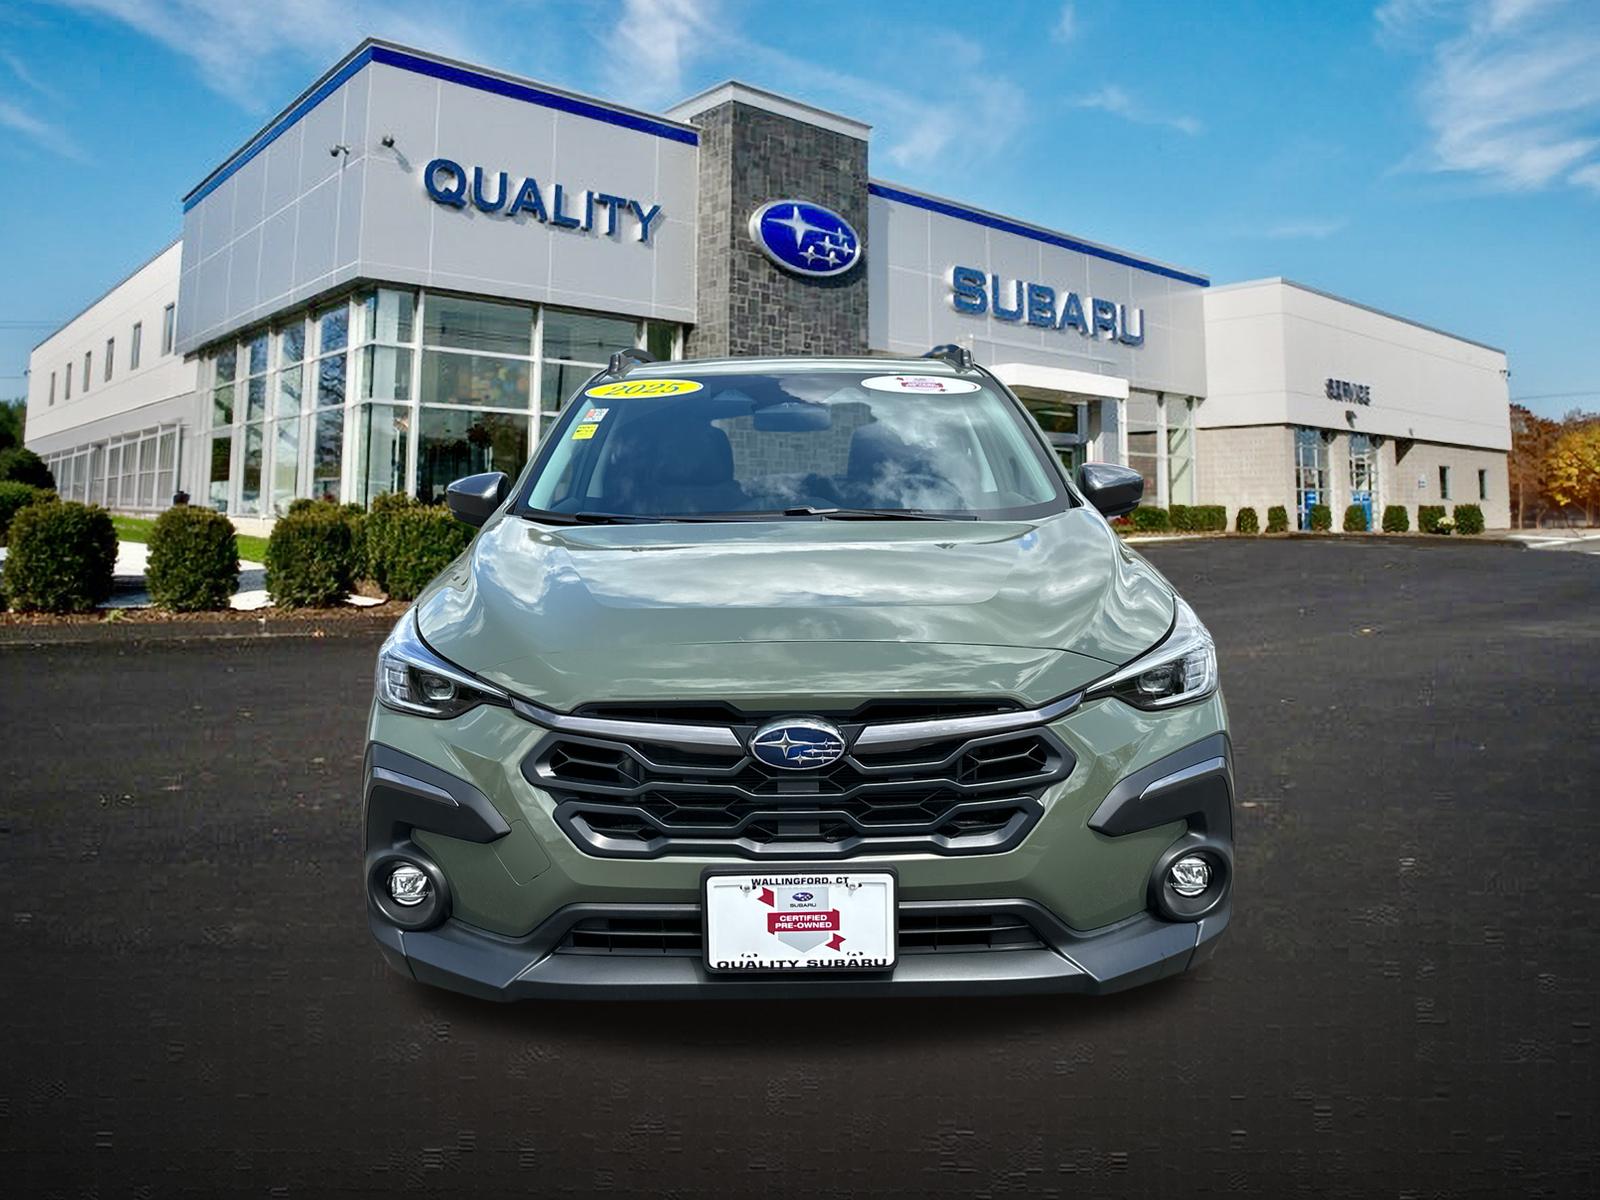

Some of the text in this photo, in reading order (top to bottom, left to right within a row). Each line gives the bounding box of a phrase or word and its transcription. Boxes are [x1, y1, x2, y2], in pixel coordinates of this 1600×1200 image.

[424, 158, 661, 242] QUALITY
[951, 265, 1144, 346] SUBARU
[604, 382, 685, 396] 2025
[1325, 378, 1371, 406] SERVICE
[836, 876, 850, 885] CT
[779, 914, 828, 922] CERTIFIED
[775, 921, 832, 929] PRE-OWNED
[717, 958, 887, 969] QUALITY SUBARU
